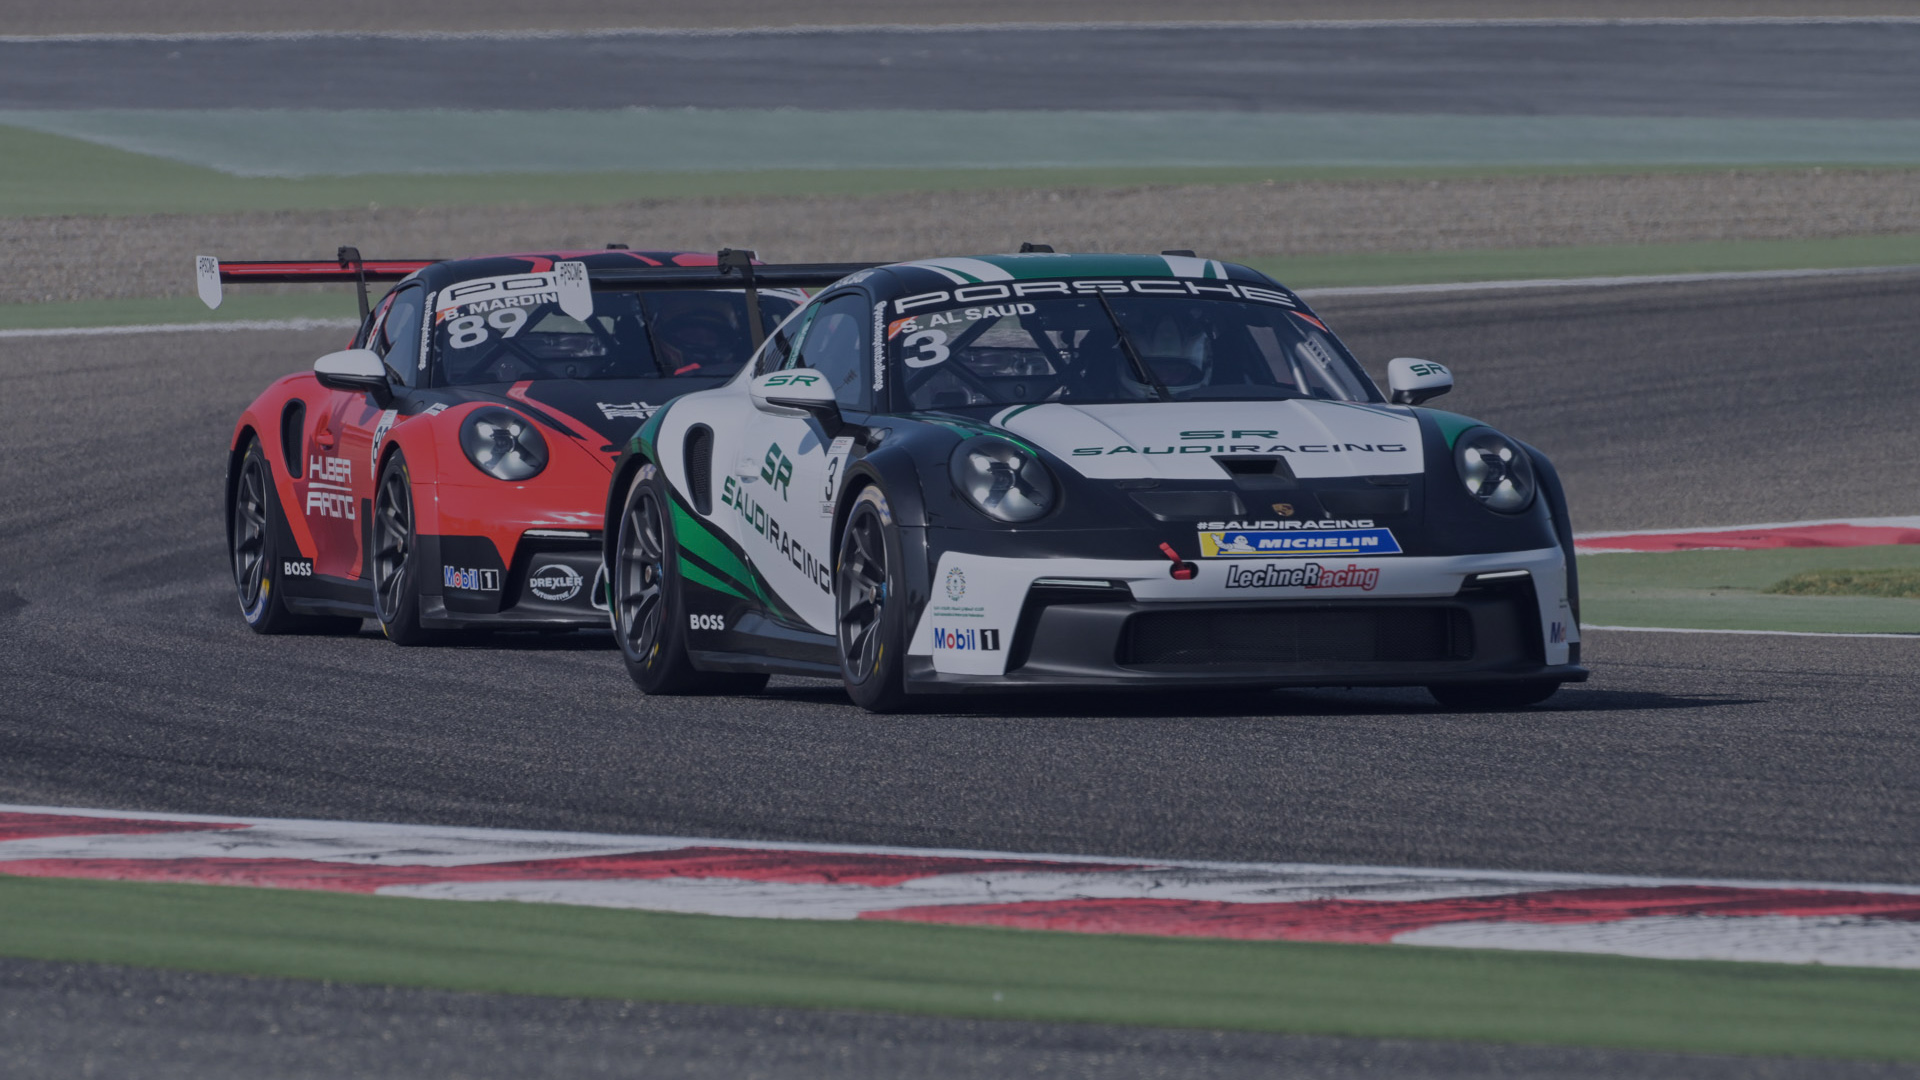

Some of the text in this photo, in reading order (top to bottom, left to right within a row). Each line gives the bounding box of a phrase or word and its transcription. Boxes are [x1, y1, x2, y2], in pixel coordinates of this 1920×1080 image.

[894, 280, 1296, 314] PORSCHE
[445, 309, 464, 321] B.
[901, 303, 1037, 333] S. AL SAUD
[447, 307, 528, 349] 89
[902, 329, 950, 368] 3
[1409, 362, 1447, 376] SR
[764, 375, 820, 387] SR
[1179, 430, 1279, 440] SR
[1072, 444, 1407, 456] SAUDIRACING
[309, 455, 352, 483] HUBER
[760, 442, 793, 502] SR
[825, 456, 838, 501] 3
[1197, 519, 1374, 530] #SAUDIRACING
[721, 475, 831, 594] SAUDIRACING
[1258, 536, 1379, 549] MICHELIN
[284, 561, 312, 576] BOSS
[444, 565, 478, 590] Mobil
[529, 576, 583, 589] DREXLER
[690, 615, 725, 630] BOSS
[934, 627, 976, 650] Mobil
